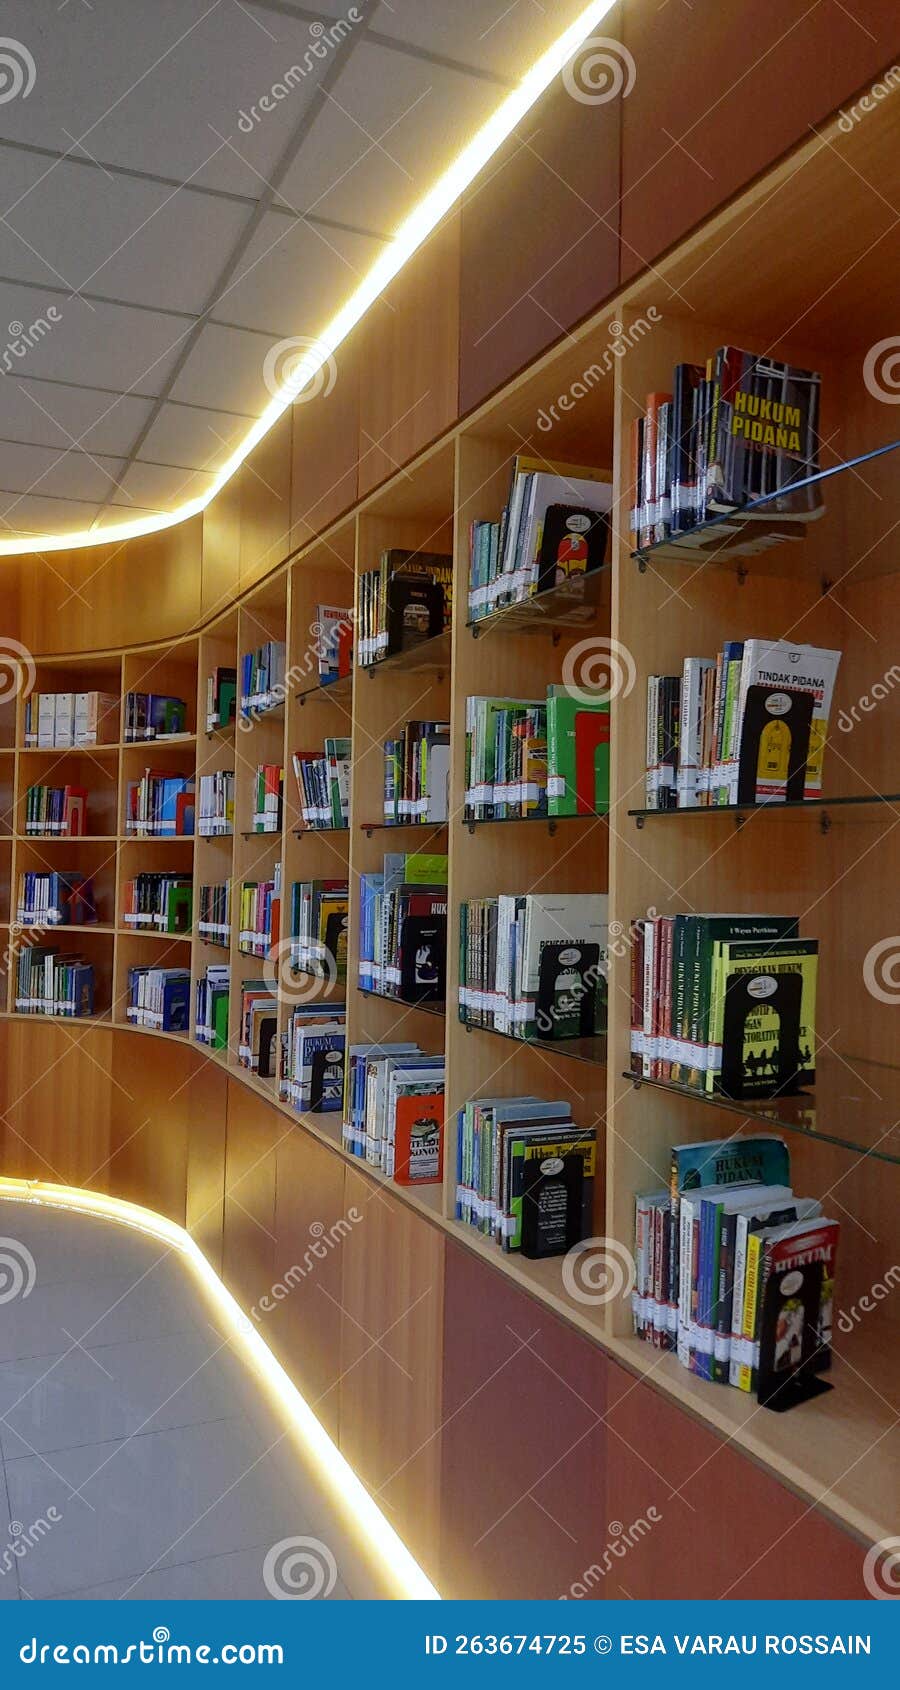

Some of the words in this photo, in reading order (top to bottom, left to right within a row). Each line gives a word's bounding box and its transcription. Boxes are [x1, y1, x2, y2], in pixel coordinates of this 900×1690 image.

[735, 391, 800, 427] HUKUM
[731, 415, 801, 452] PIDANA
[757, 670, 791, 684] TINDAK
[792, 675, 825, 688] PIDANA
[431, 902, 448, 915] HUK
[715, 1156, 764, 1172] HUKUM
[715, 1168, 764, 1184] PIDANA
